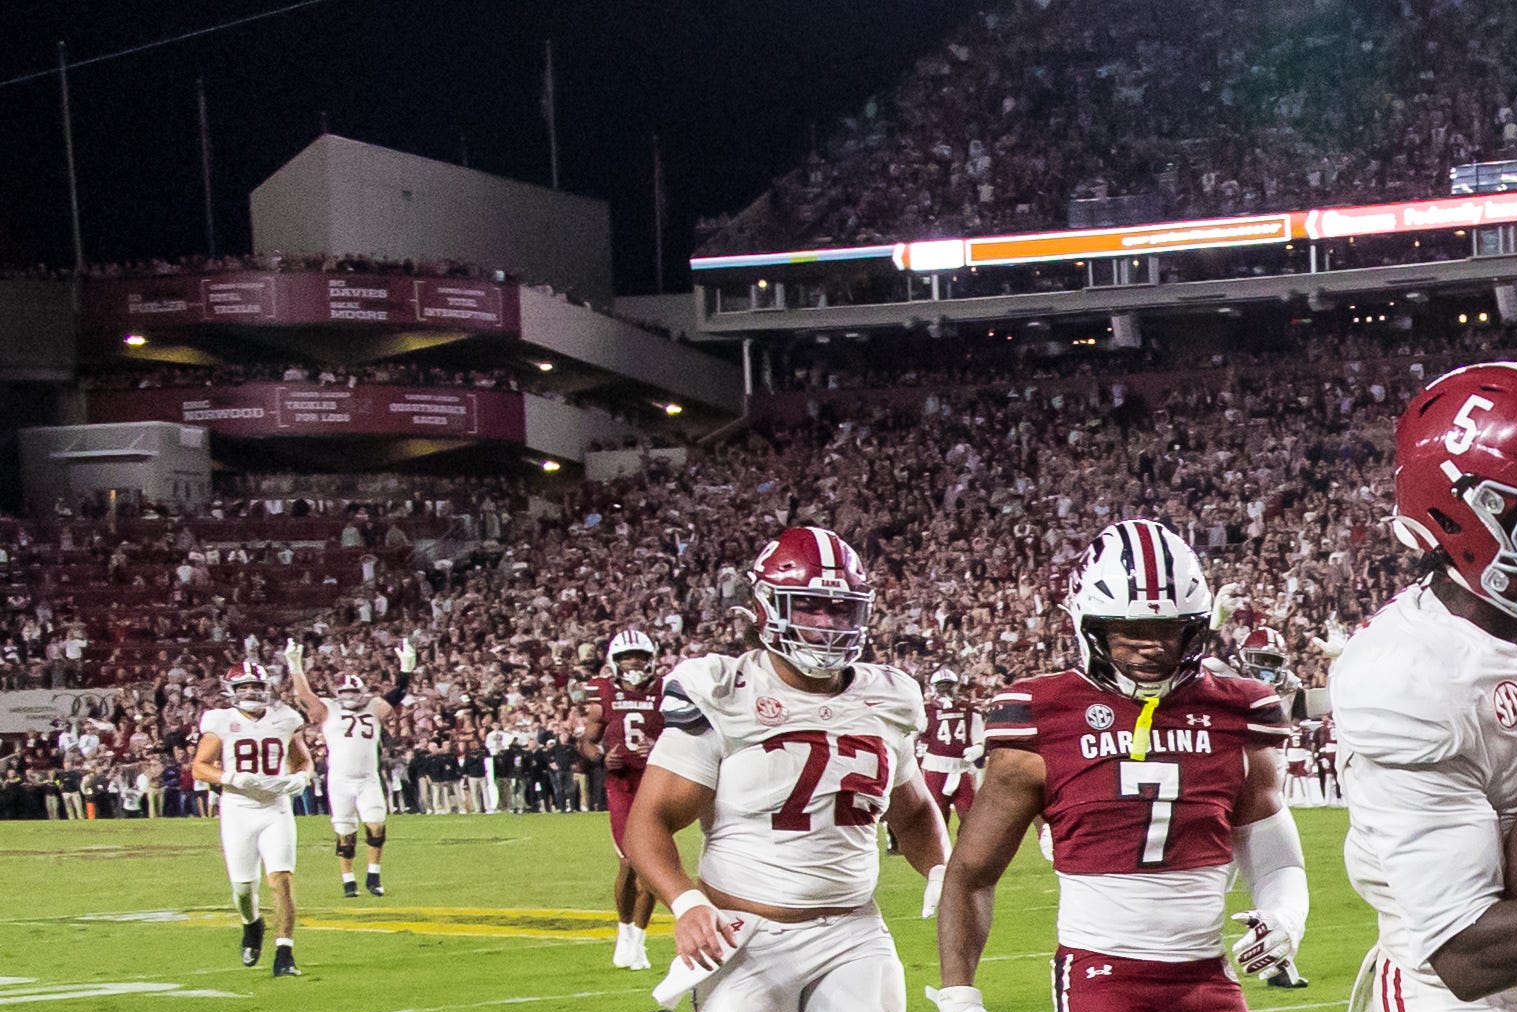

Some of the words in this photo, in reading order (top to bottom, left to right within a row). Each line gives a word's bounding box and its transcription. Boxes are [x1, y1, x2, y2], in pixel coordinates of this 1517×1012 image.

[330, 288, 387, 299] DAVIES
[331, 309, 387, 321] MOORE
[184, 408, 264, 421] NORWOOD
[1443, 394, 1494, 455] 5
[341, 713, 374, 740] 75
[1086, 704, 1115, 730] SEC
[623, 712, 645, 751] 6
[937, 719, 966, 745] 44
[1080, 729, 1212, 759] CARLINA
[234, 737, 284, 775] 80
[763, 730, 890, 831] 72
[1118, 760, 1181, 865] 7
